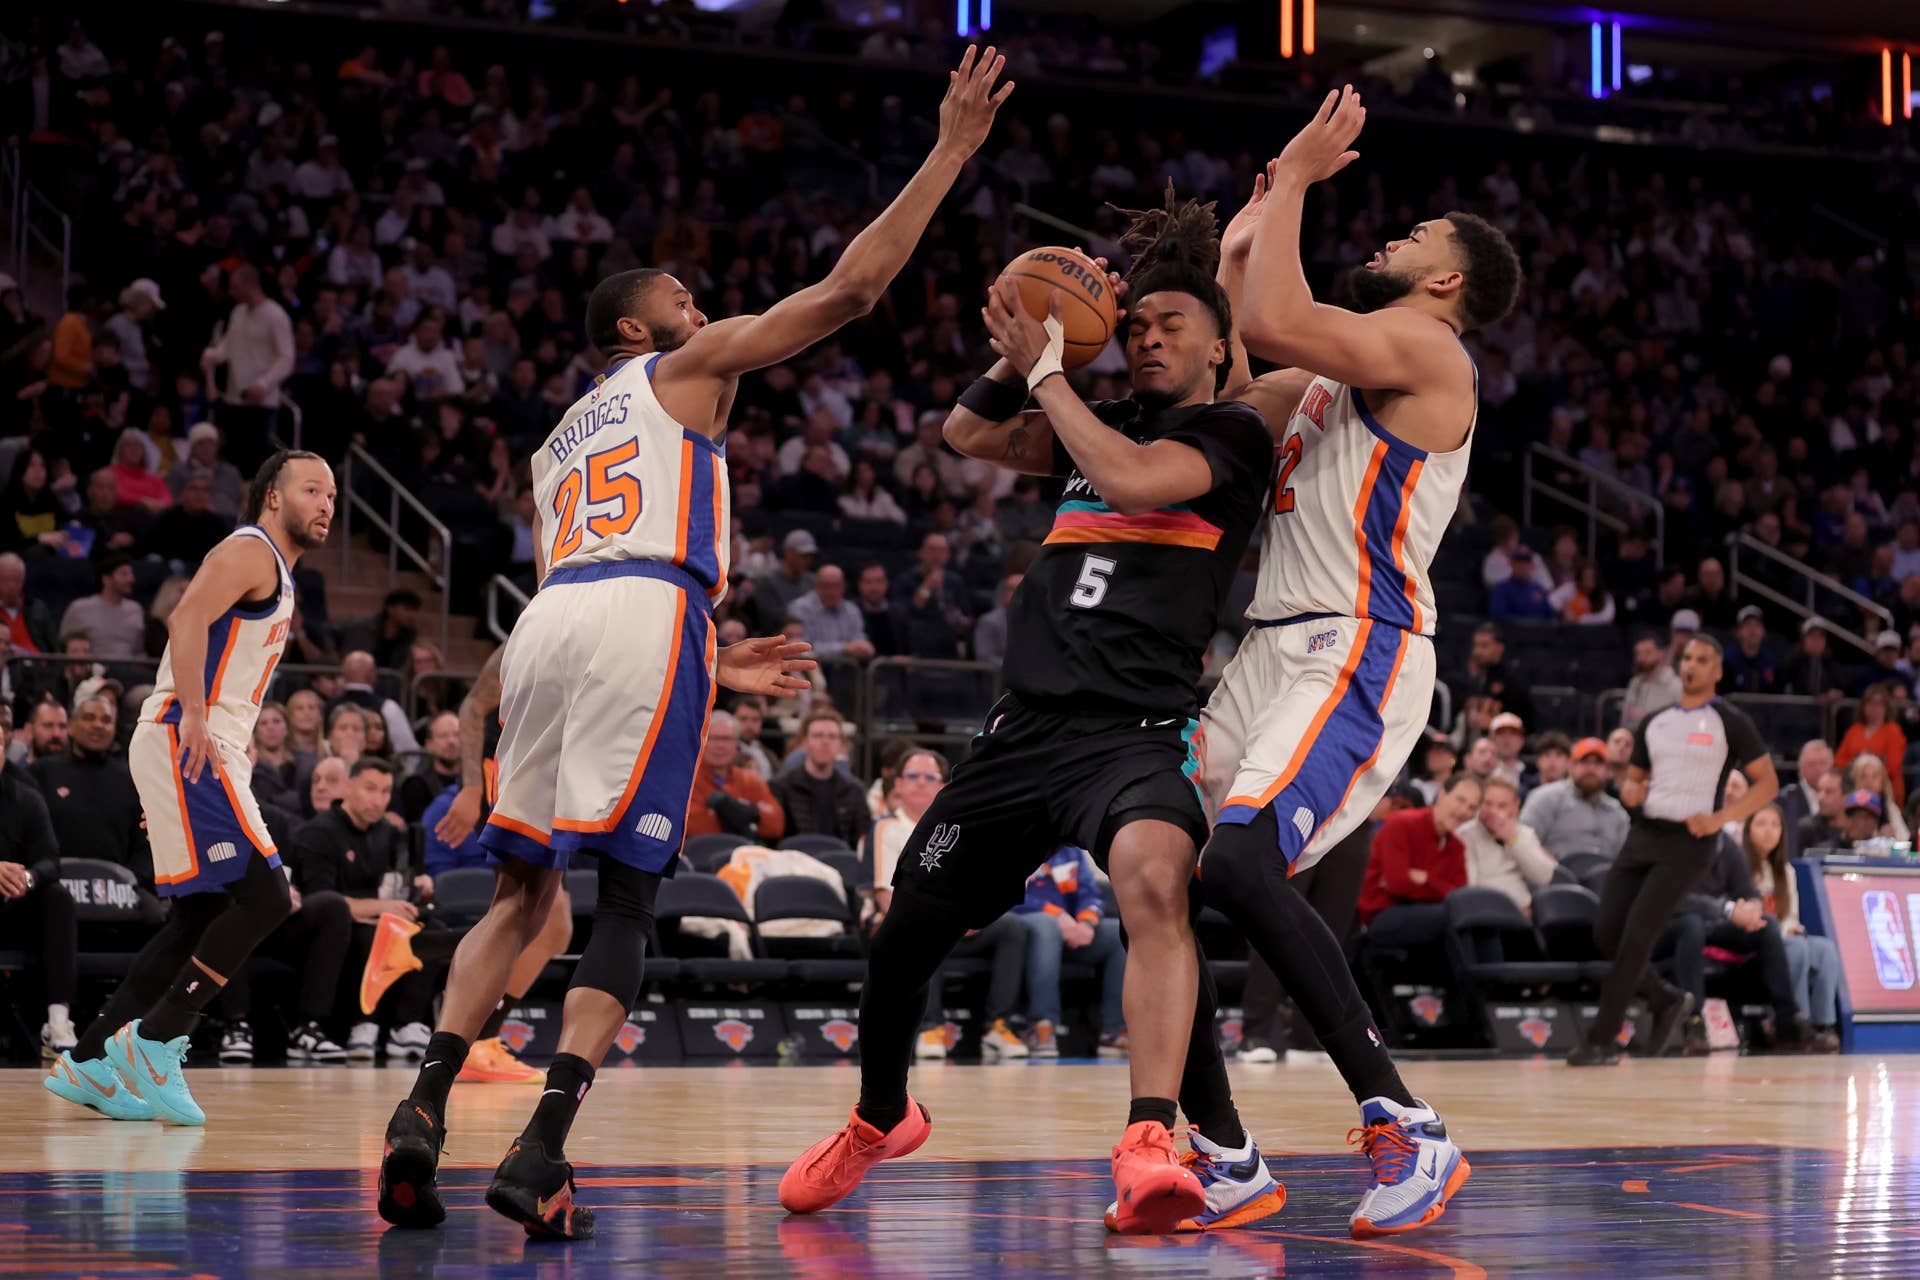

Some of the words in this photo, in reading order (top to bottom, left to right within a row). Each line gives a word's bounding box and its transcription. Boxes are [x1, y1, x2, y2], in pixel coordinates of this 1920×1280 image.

[1028, 253, 1104, 302] Wilson
[549, 393, 632, 466] BRIDGES
[550, 435, 643, 566] 25
[1273, 431, 1304, 515] 2
[1069, 552, 1118, 609] 5
[1307, 629, 1338, 654] NYC
